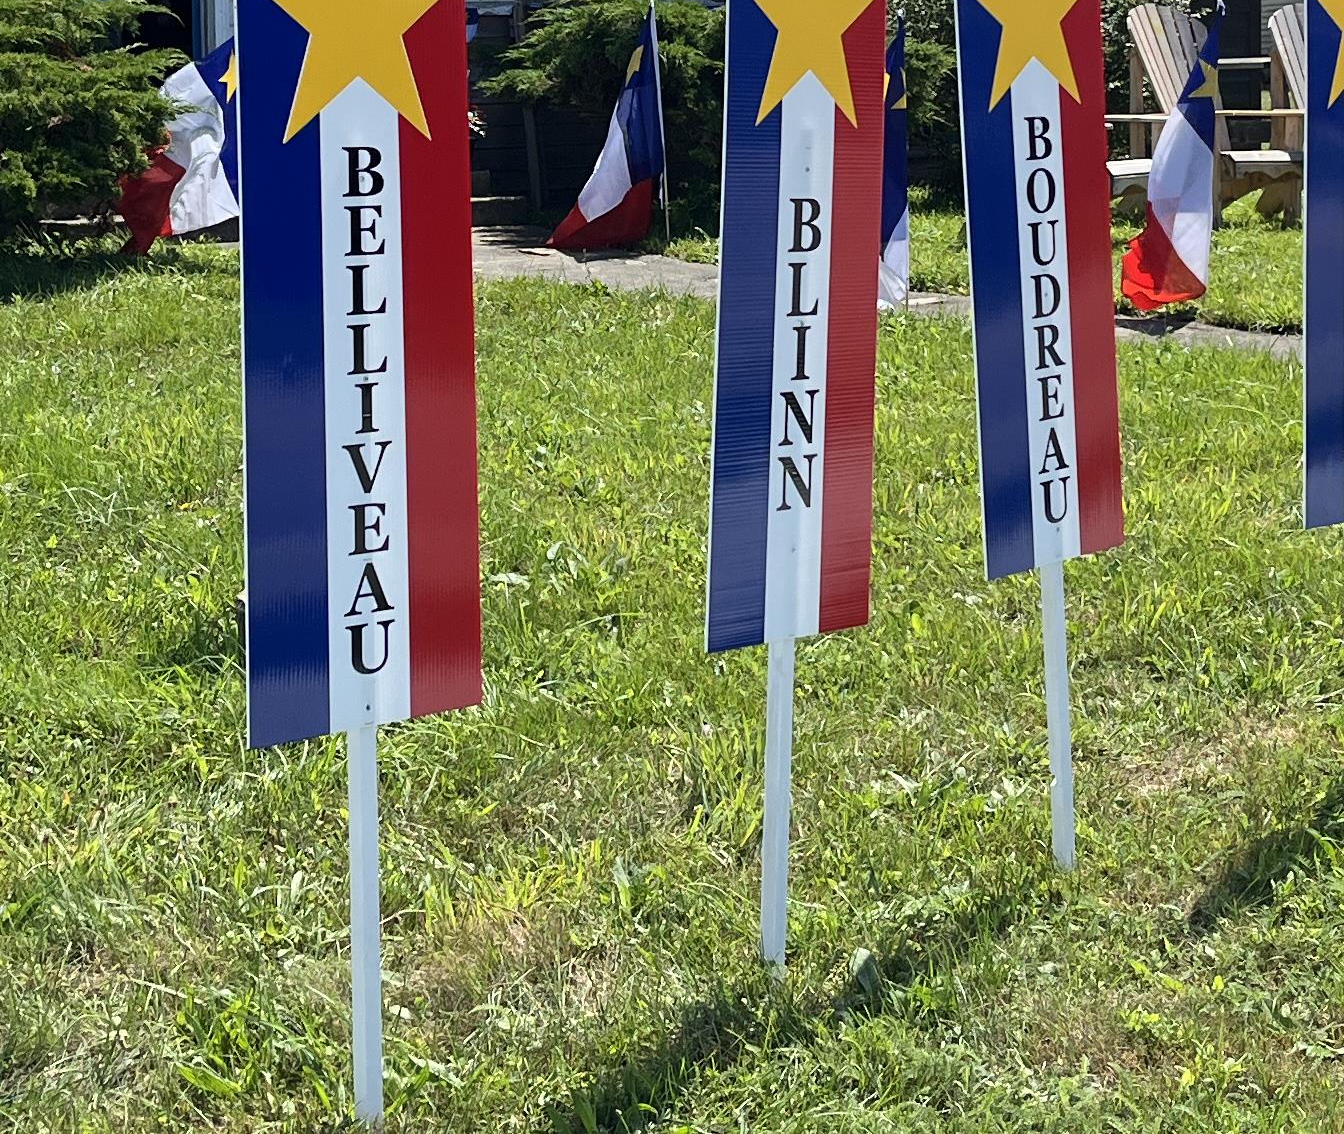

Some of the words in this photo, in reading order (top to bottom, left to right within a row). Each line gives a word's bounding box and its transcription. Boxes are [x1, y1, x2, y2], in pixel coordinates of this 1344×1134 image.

[341, 145, 395, 676] BELLIVEAU
[775, 197, 823, 512] BLINN
[1023, 115, 1069, 526] BOUDREAU
